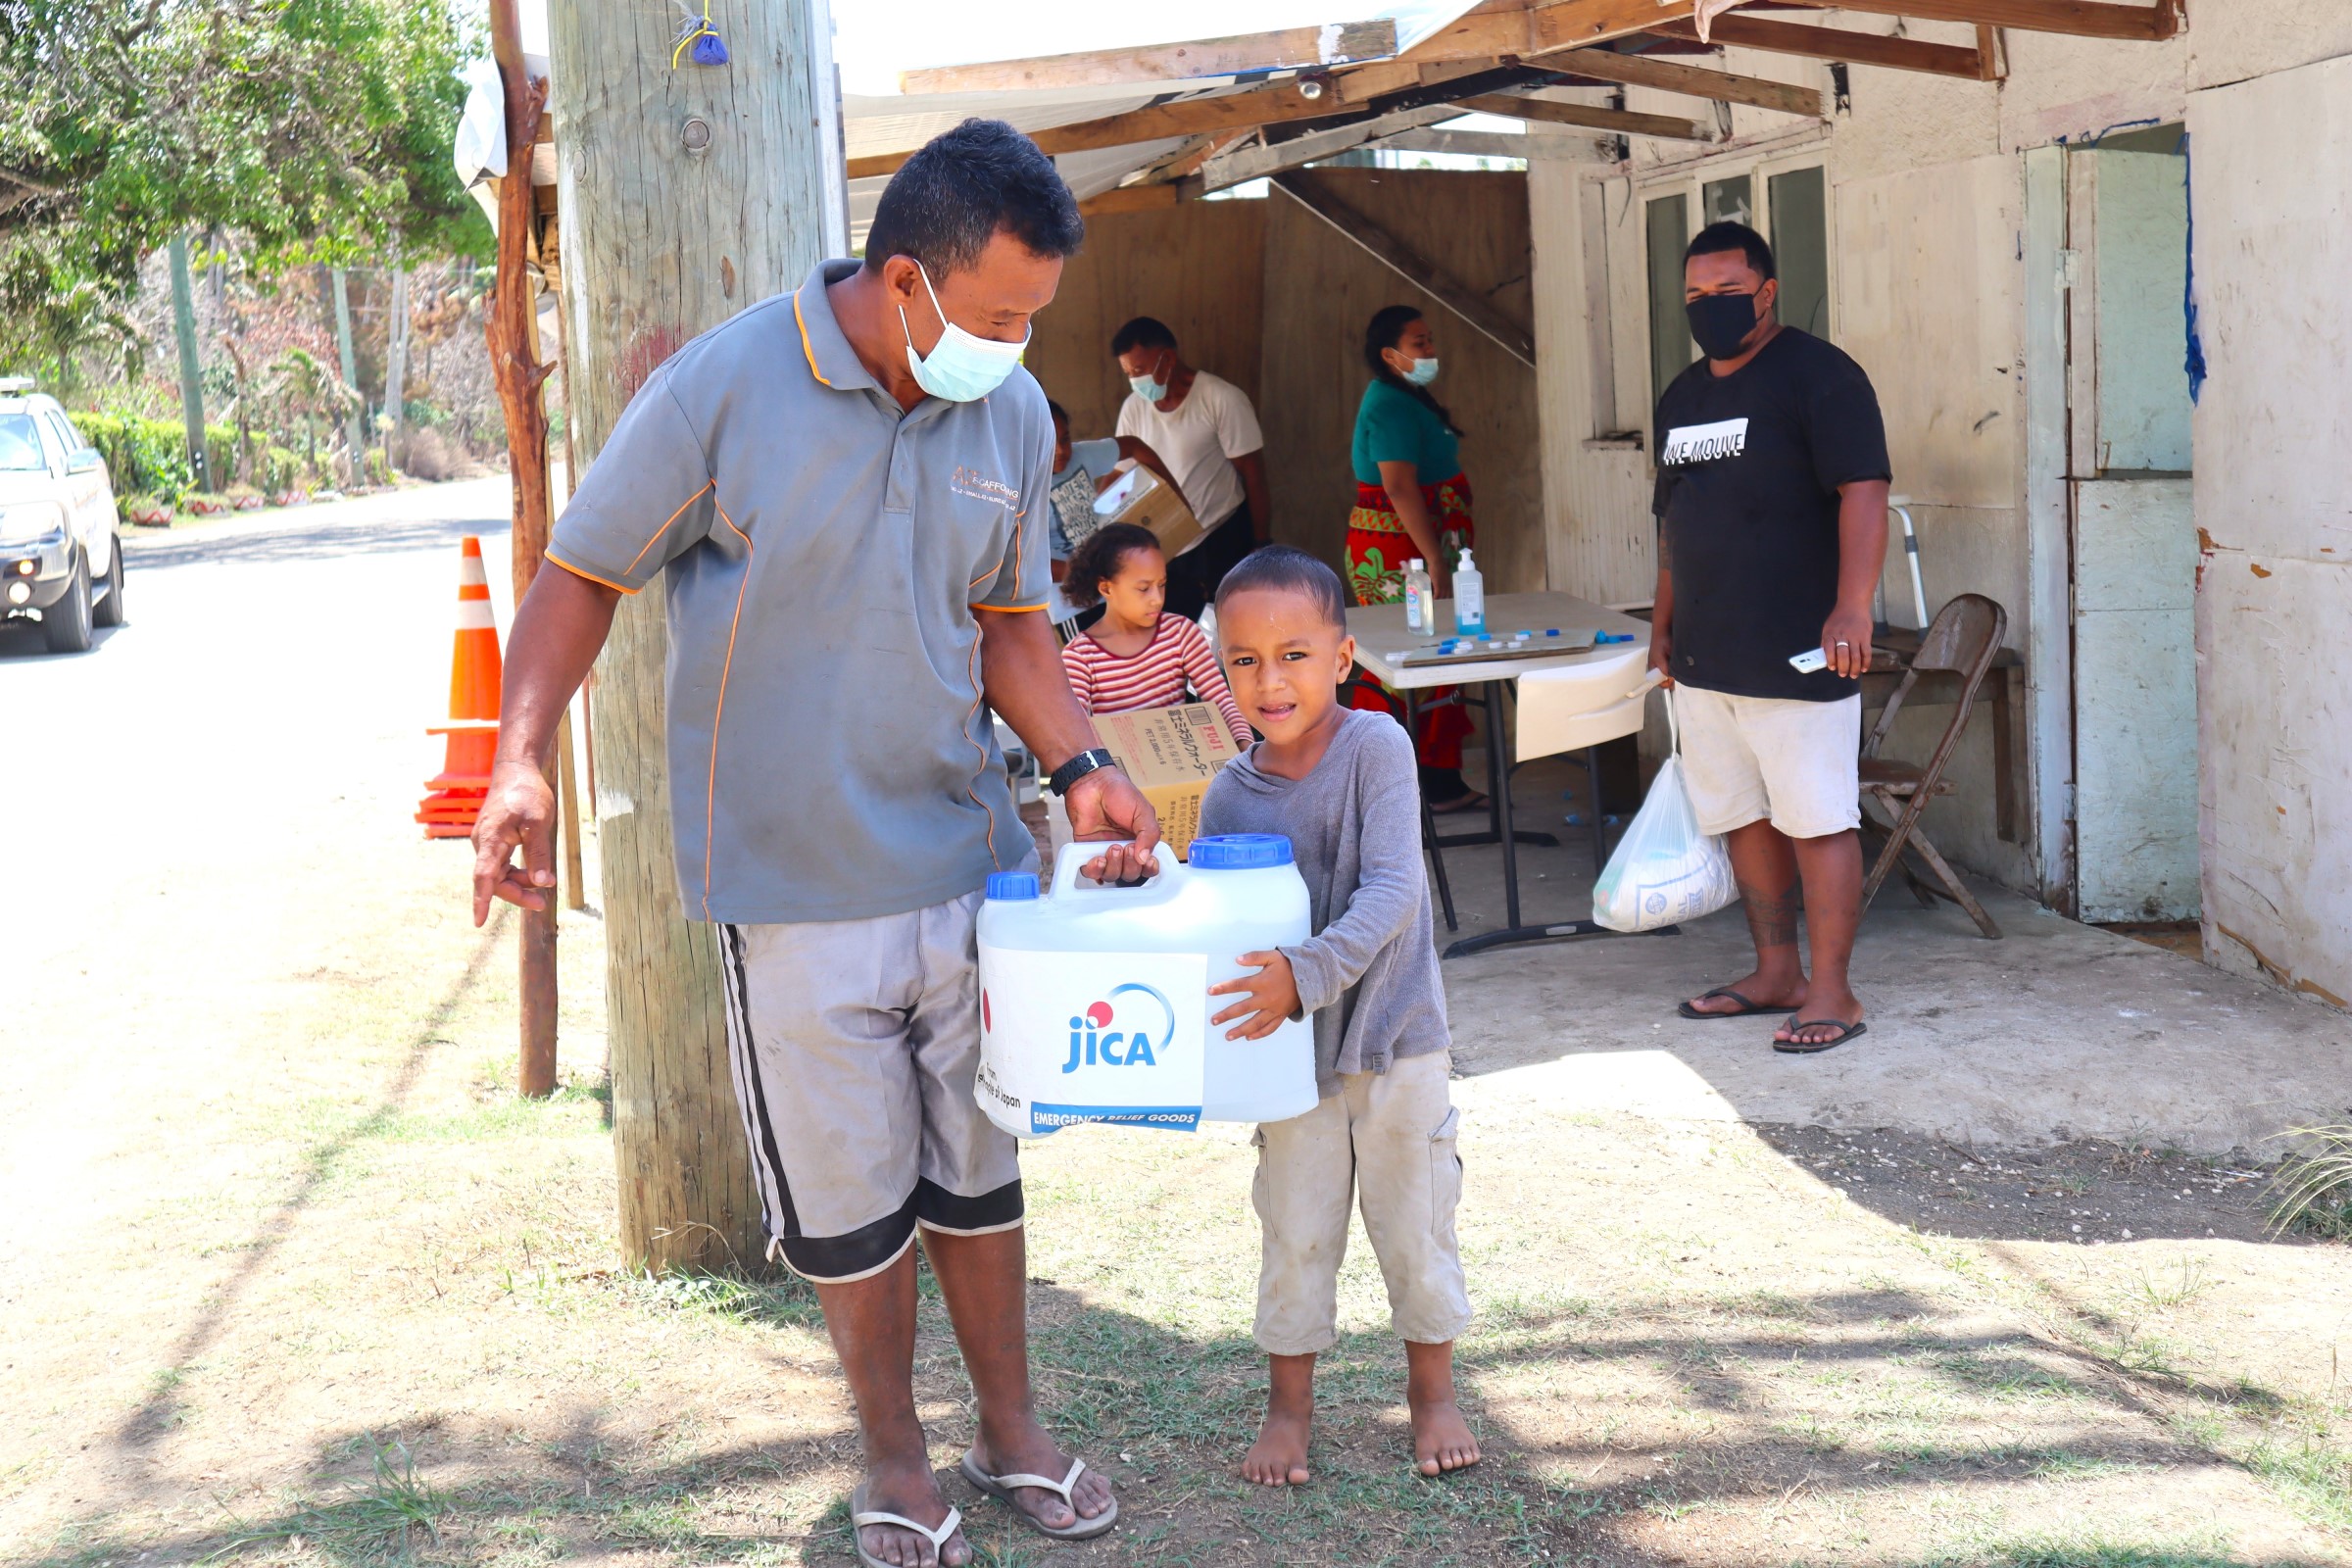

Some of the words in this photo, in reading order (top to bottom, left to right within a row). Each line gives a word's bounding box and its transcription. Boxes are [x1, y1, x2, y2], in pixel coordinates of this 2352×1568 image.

[1665, 442, 1689, 466] WE
[1690, 433, 1743, 463] MOUVE
[1202, 725, 1224, 751] FUJI
[1148, 1113, 1196, 1124] GOODS
